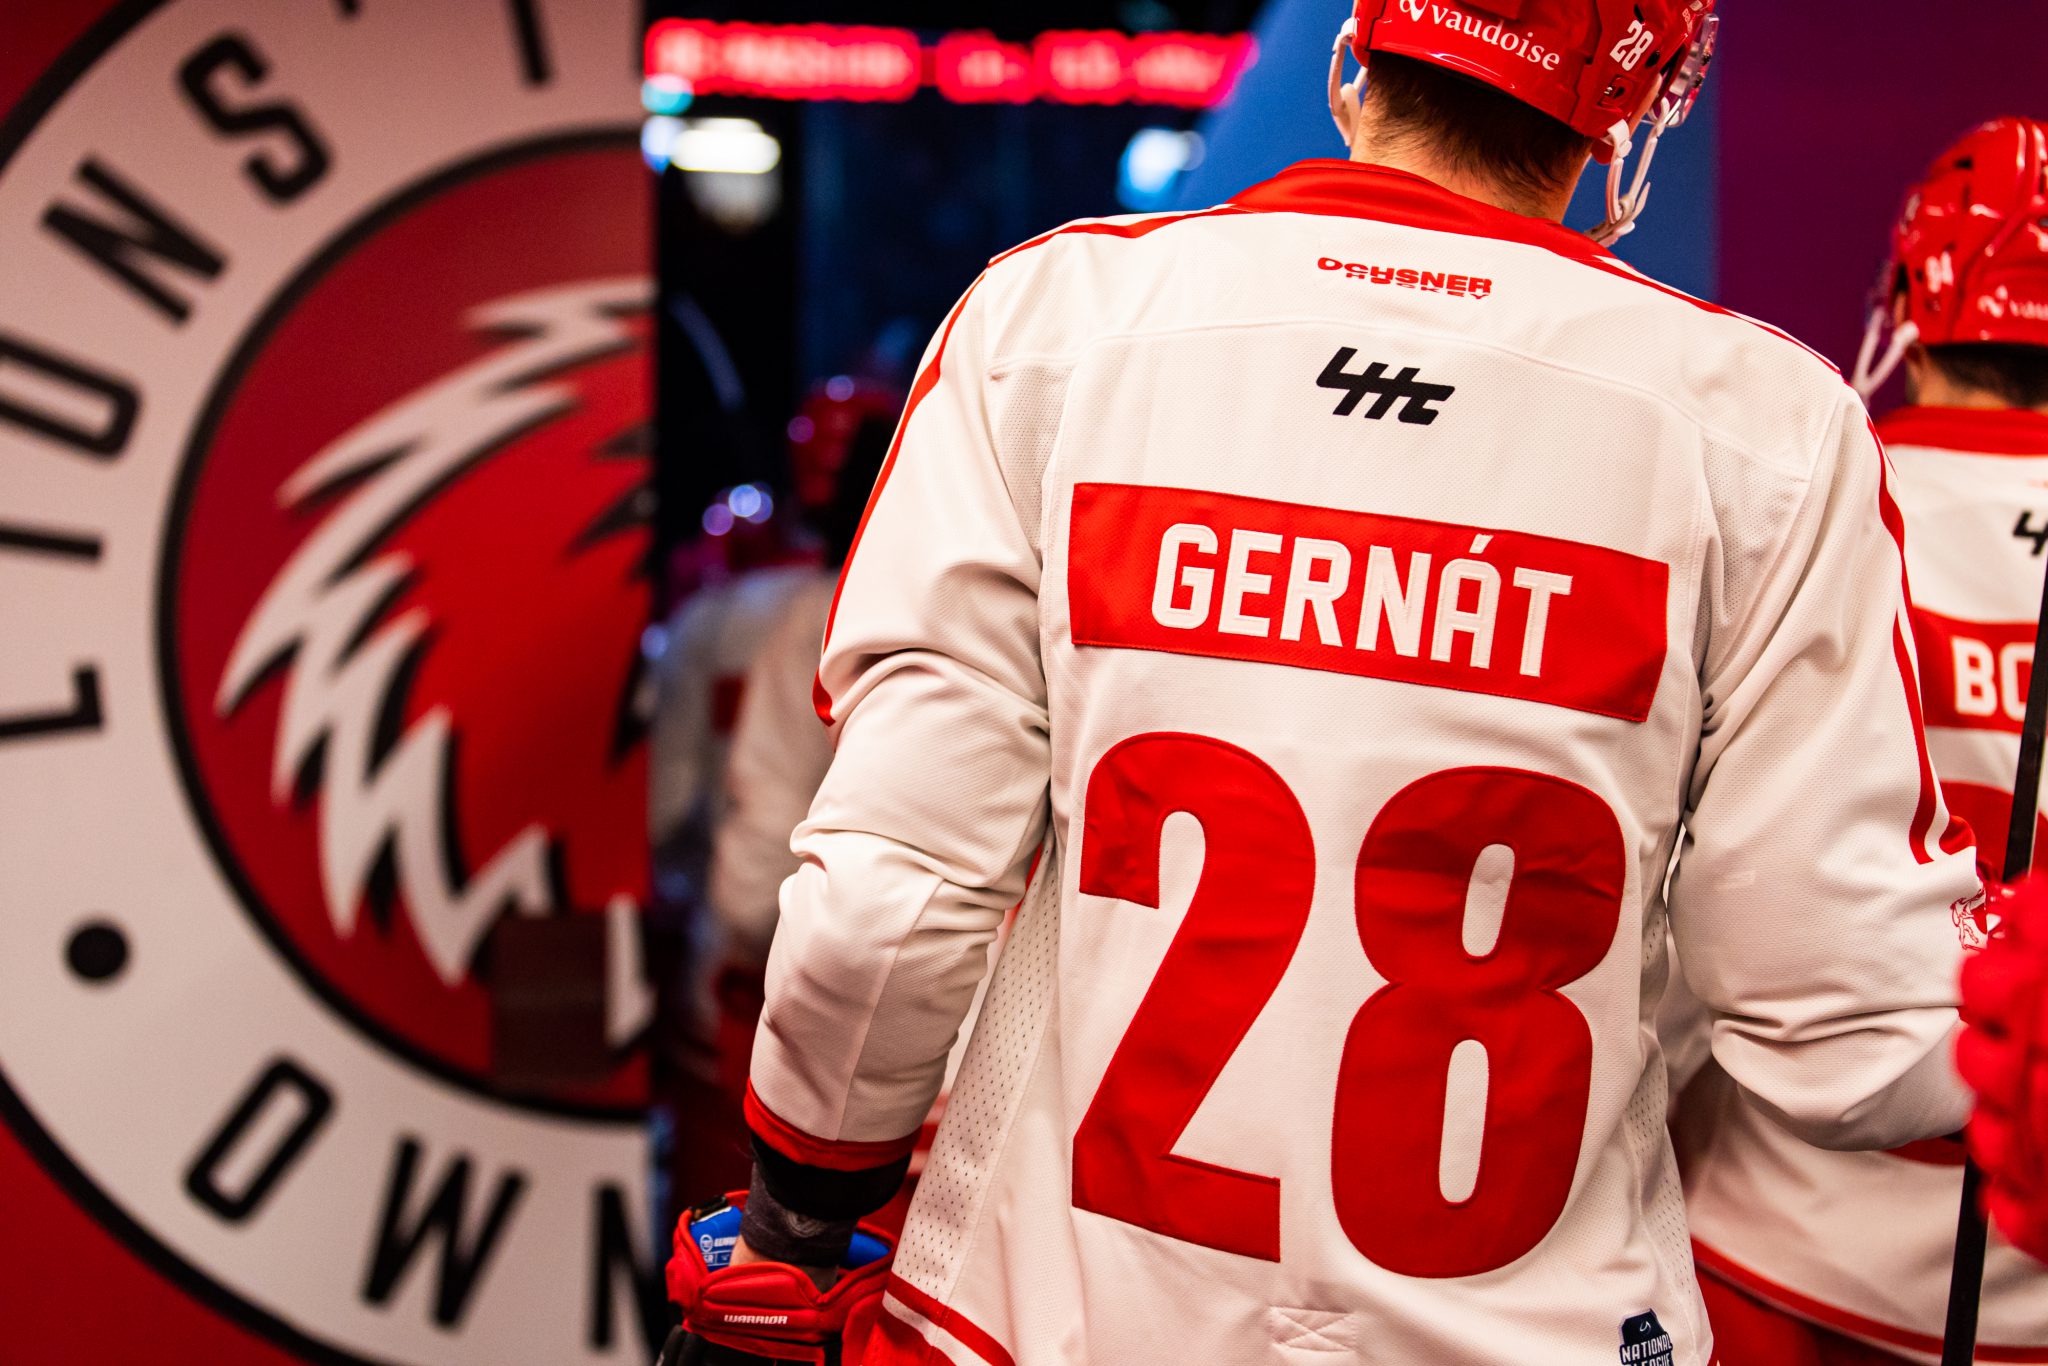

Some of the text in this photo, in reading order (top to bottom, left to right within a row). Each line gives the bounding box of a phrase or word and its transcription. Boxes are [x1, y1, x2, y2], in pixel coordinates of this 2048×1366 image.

[1432, 4, 1561, 71] vaudoise
[1609, 20, 1655, 72] 28
[1317, 256, 1493, 294] OCHSNER
[1151, 522, 1574, 678] GERNÁT
[1072, 731, 1627, 1279] 28
[723, 1314, 788, 1325] WARRIOR
[1621, 1333, 1671, 1363] NATIONAL
[1633, 1352, 1670, 1366] GUE
